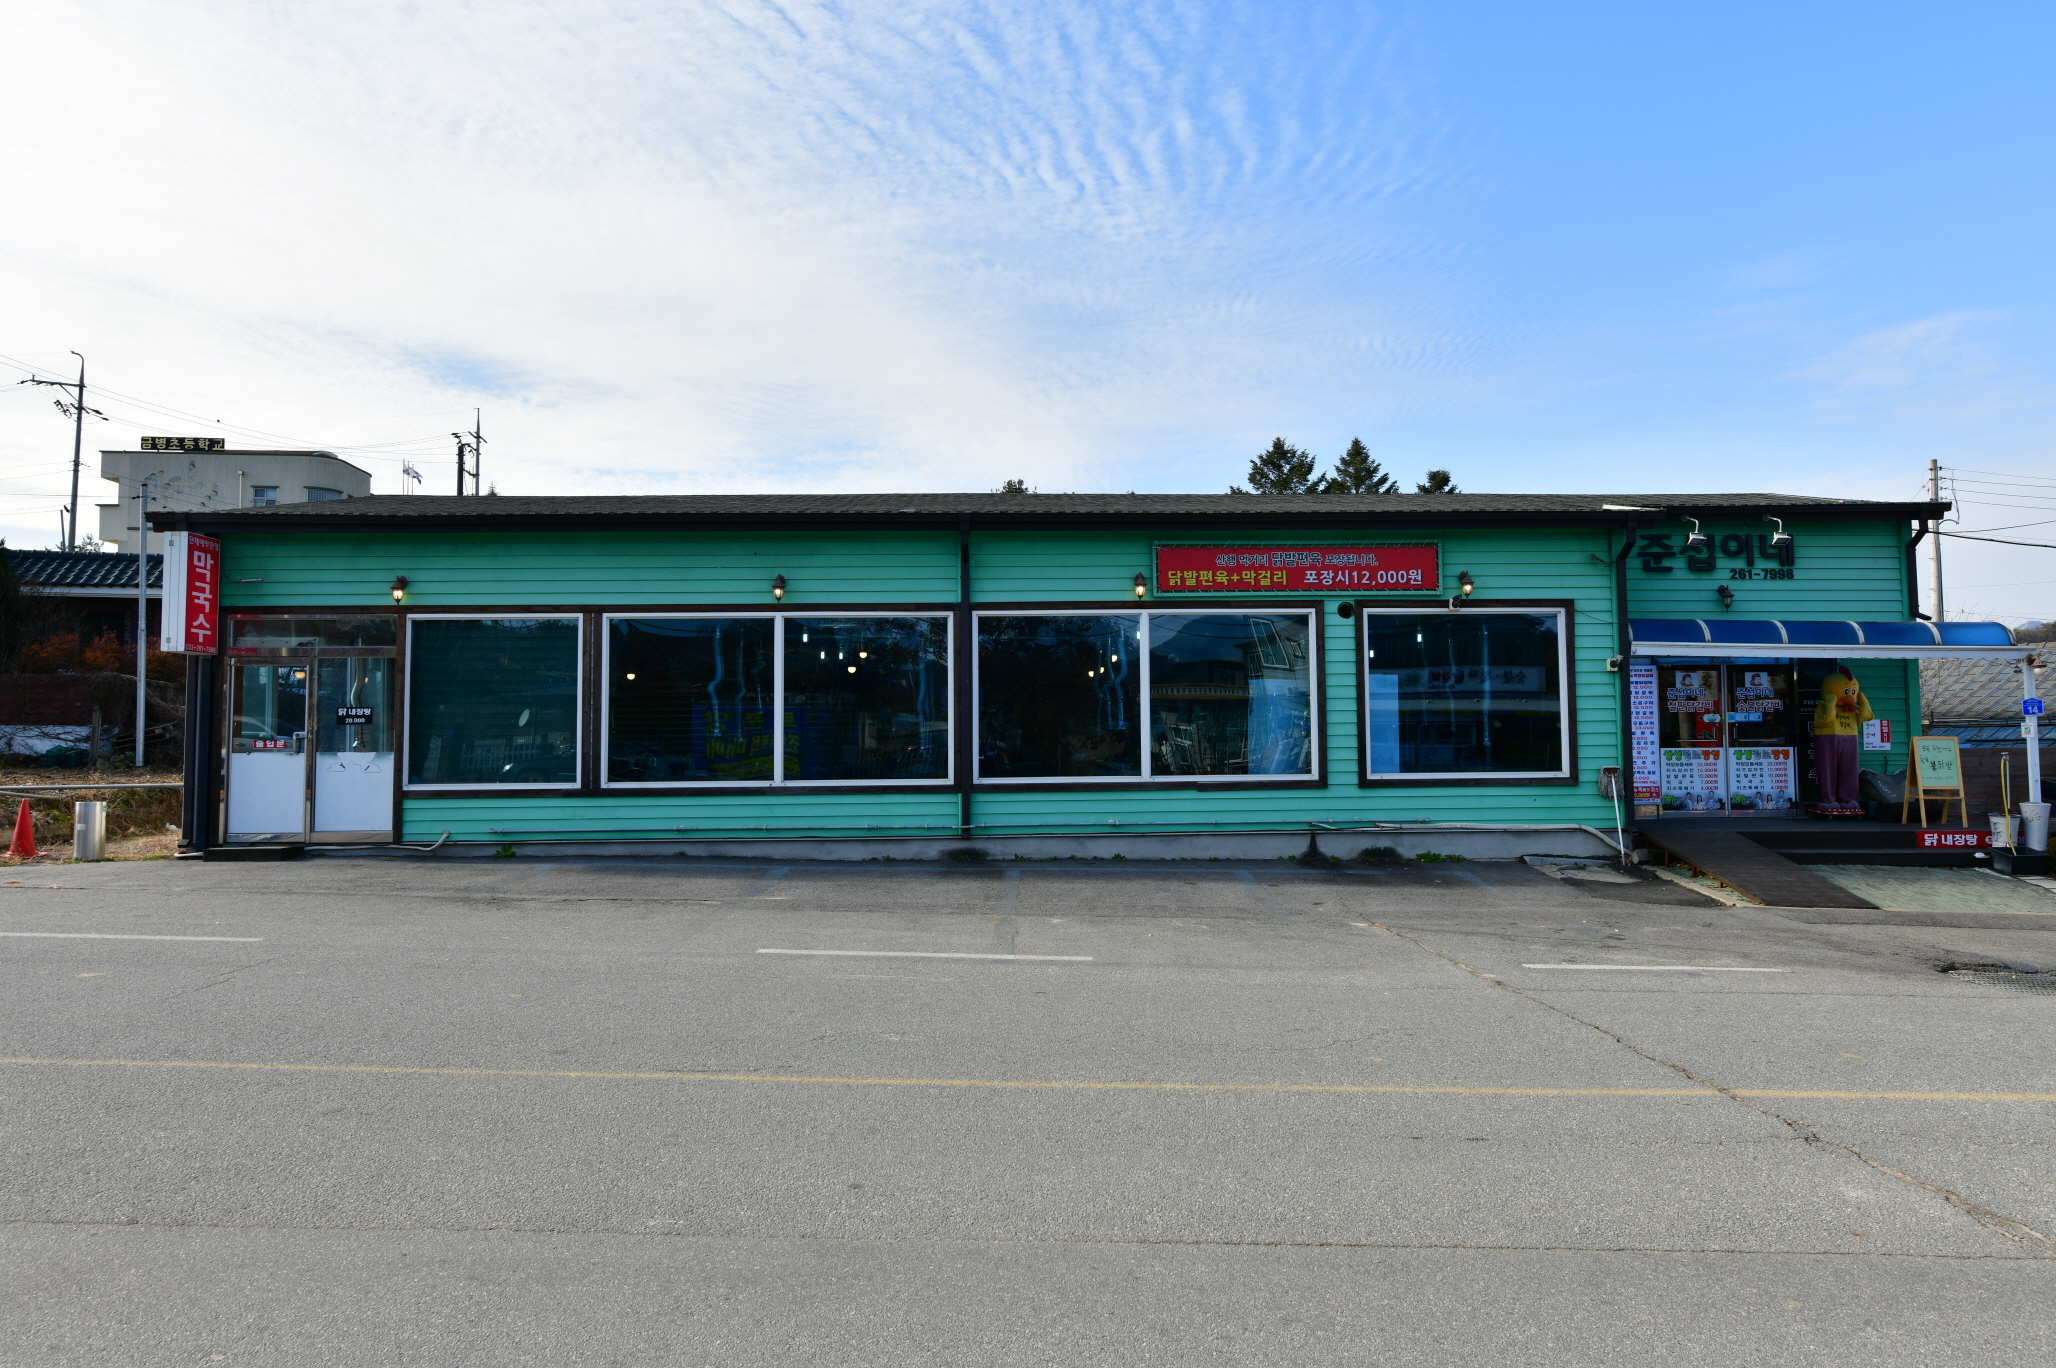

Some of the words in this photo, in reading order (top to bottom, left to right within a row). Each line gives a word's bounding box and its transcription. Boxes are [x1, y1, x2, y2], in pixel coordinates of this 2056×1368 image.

[141, 437, 225, 450] 금병초등학교
[189, 536, 219, 552] 단체예약환영
[1215, 553, 1236, 566] 산행
[1239, 554, 1269, 566] 먹거리
[1271, 551, 1322, 567] 닭발편육
[1324, 554, 1379, 566] 포장됩니다.
[1168, 570, 1288, 586] 닭발편육+막걸리
[1304, 569, 1422, 585] 포장시12,000원
[1730, 568, 1794, 580] 261-7998
[191, 550, 214, 642] 막국수
[1666, 688, 1706, 699] 준섭이네
[1736, 687, 1775, 700] 준섭이네
[1667, 700, 1714, 712] 철판닭갈비
[1737, 700, 1784, 712] 숯불닭갈비
[1924, 833, 1939, 846] 닭
[1941, 834, 1978, 846] 내장탕
